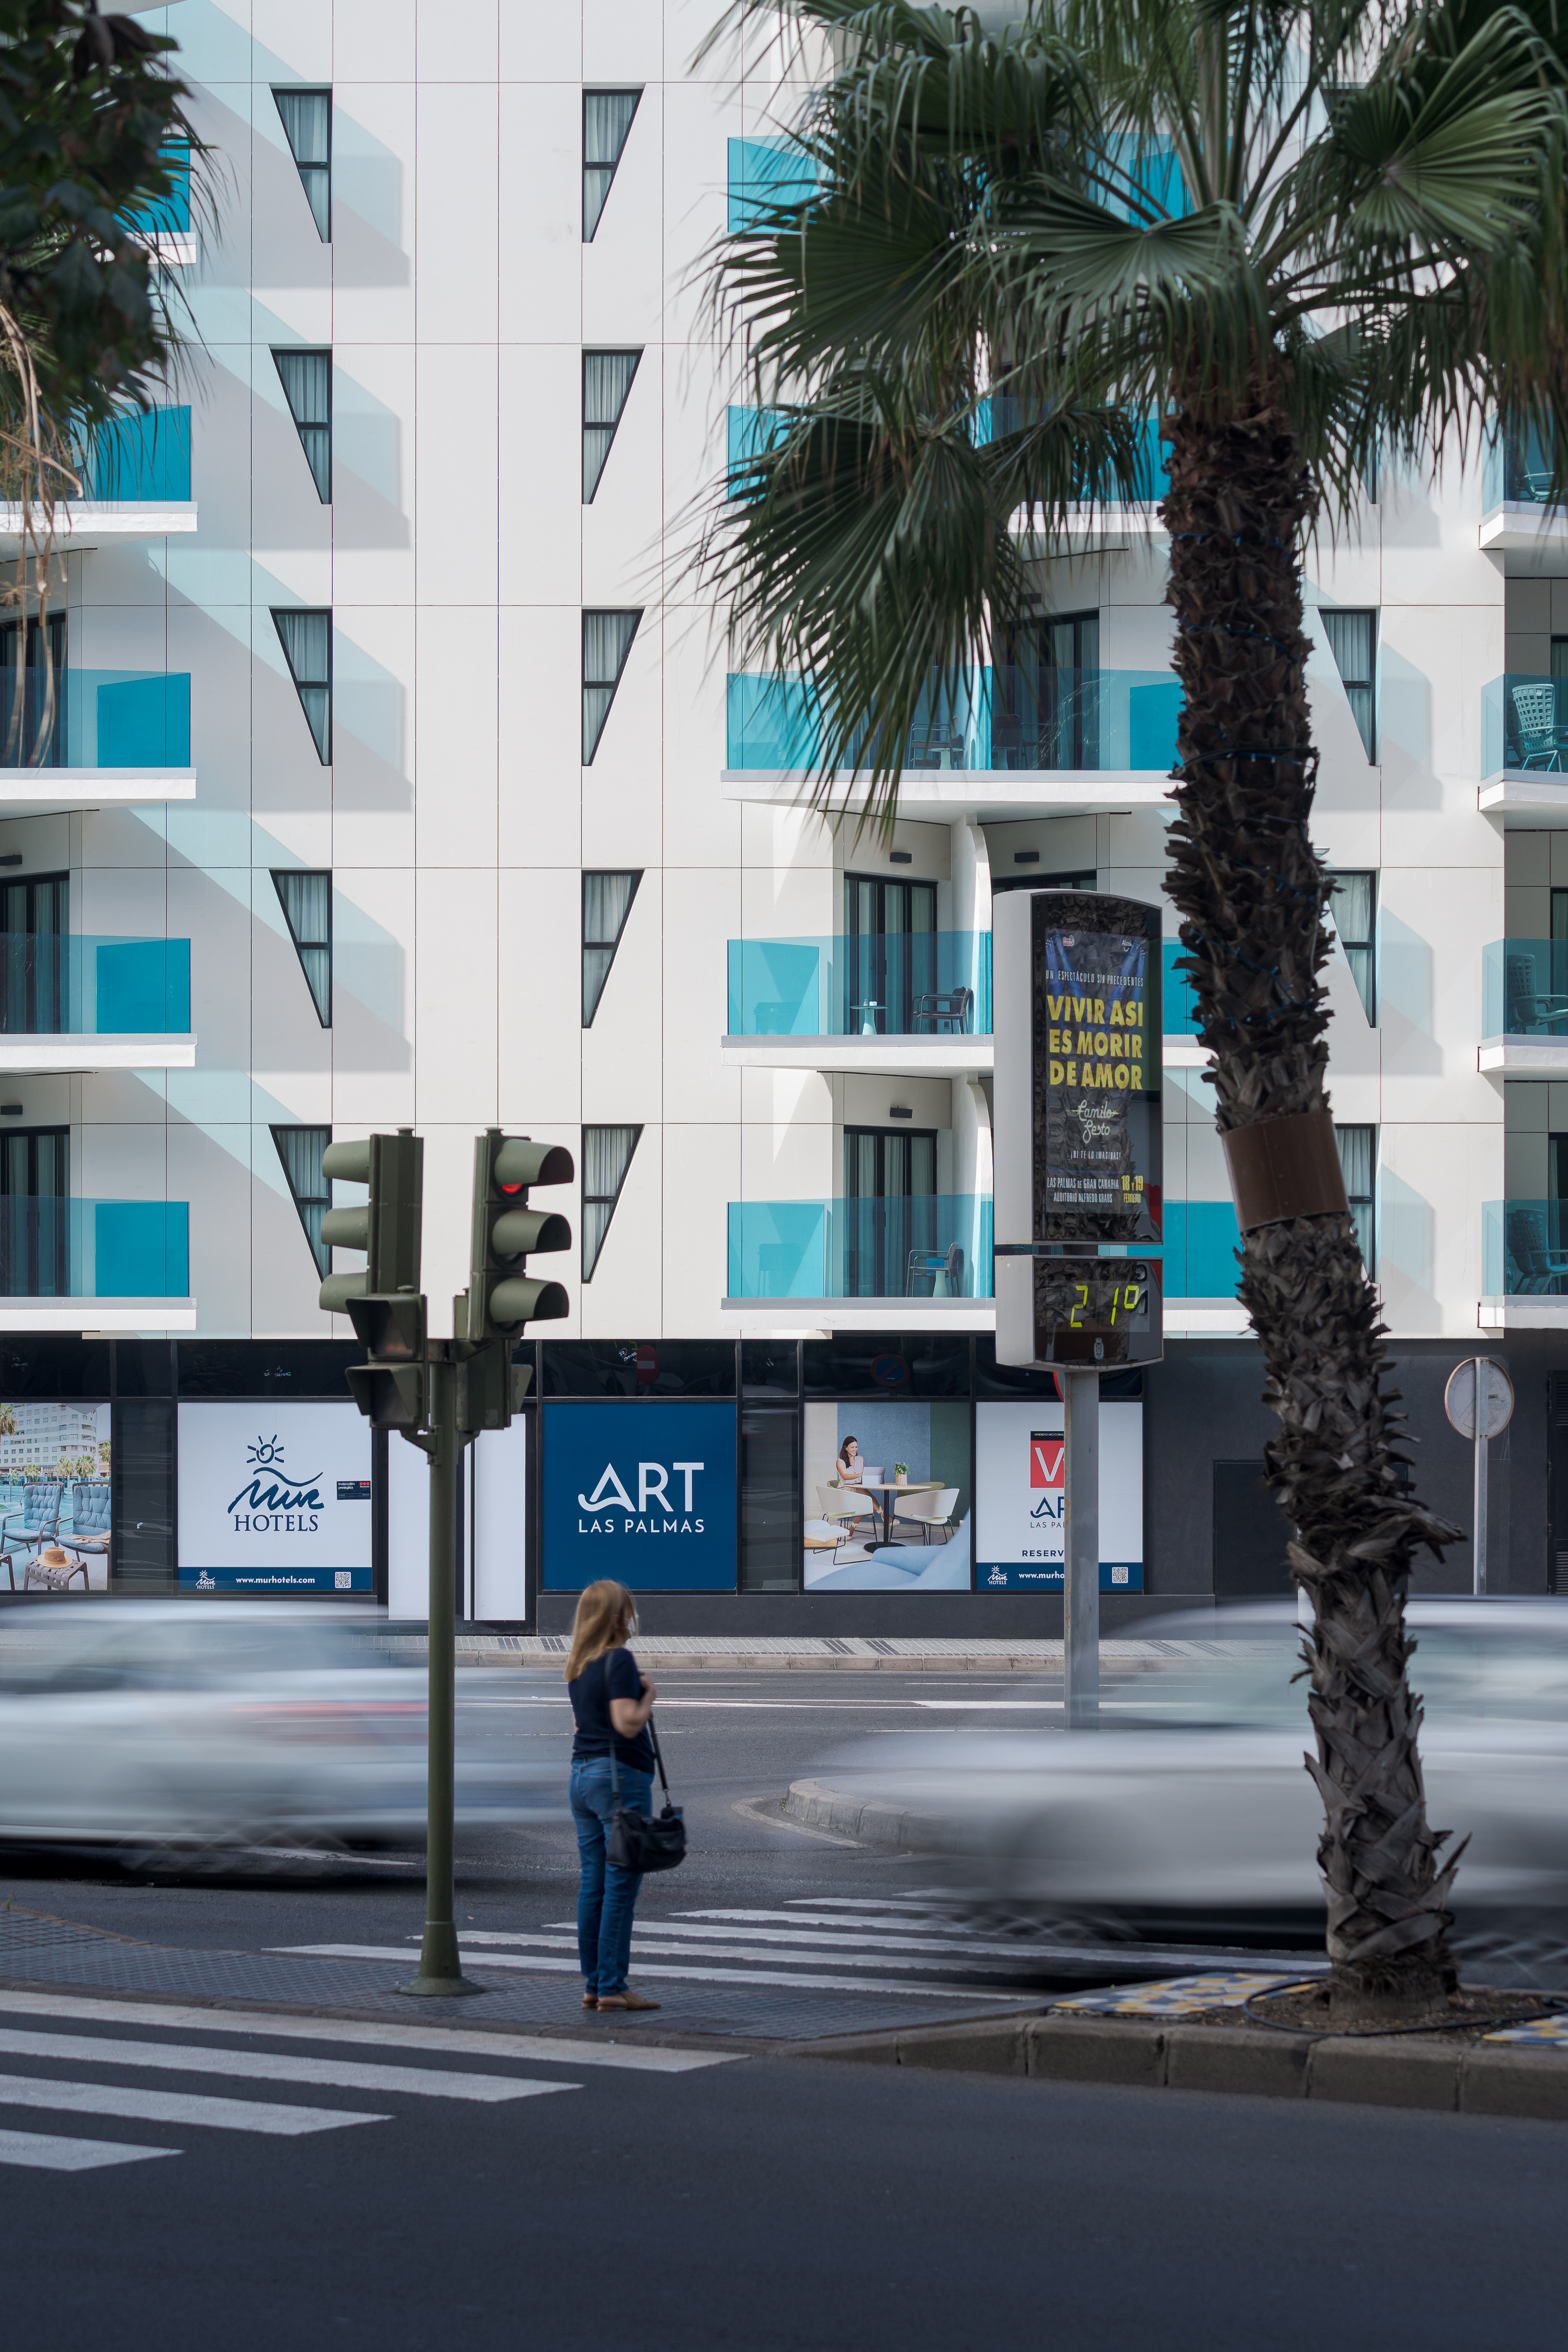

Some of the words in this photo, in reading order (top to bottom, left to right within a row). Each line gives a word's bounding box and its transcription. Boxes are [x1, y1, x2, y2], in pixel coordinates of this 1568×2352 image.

[1046, 970, 1053, 979] UN
[1058, 970, 1094, 983] ESPECTÁCULO
[1108, 975, 1143, 987] PRECEDENTES
[1047, 995, 1105, 1024] VIVIR
[1110, 1000, 1143, 1026] ASI
[1050, 1029, 1072, 1054] ES
[1076, 1031, 1142, 1058] MORIR
[1050, 1060, 1076, 1086] DE
[1081, 1062, 1142, 1090] AMOR
[1078, 1099, 1112, 1121] Camilo
[1083, 1119, 1110, 1144] Sesto
[1081, 1150, 1086, 1159] TE
[1088, 1151, 1094, 1159] LO
[1096, 1151, 1121, 1160] IMAGINAS!
[1047, 1177, 1056, 1188] LAS
[1057, 1178, 1076, 1189] PALMAS
[1077, 1180, 1082, 1189] DE
[1084, 1178, 1096, 1189] GRAN
[1098, 1179, 1119, 1190] CANARIA
[1121, 1175, 1130, 1190] 18
[1134, 1175, 1143, 1191] 19
[1053, 1192, 1077, 1202] AUDITORIO
[1078, 1193, 1097, 1202] ALFREDO
[1099, 1193, 1112, 1203] KRAUS
[1123, 1193, 1141, 1203] FEBRERO
[578, 1463, 704, 1512] ART
[234, 1515, 318, 1531] HOTELS
[579, 1519, 614, 1533] LAS
[625, 1519, 704, 1533] PALMAS
